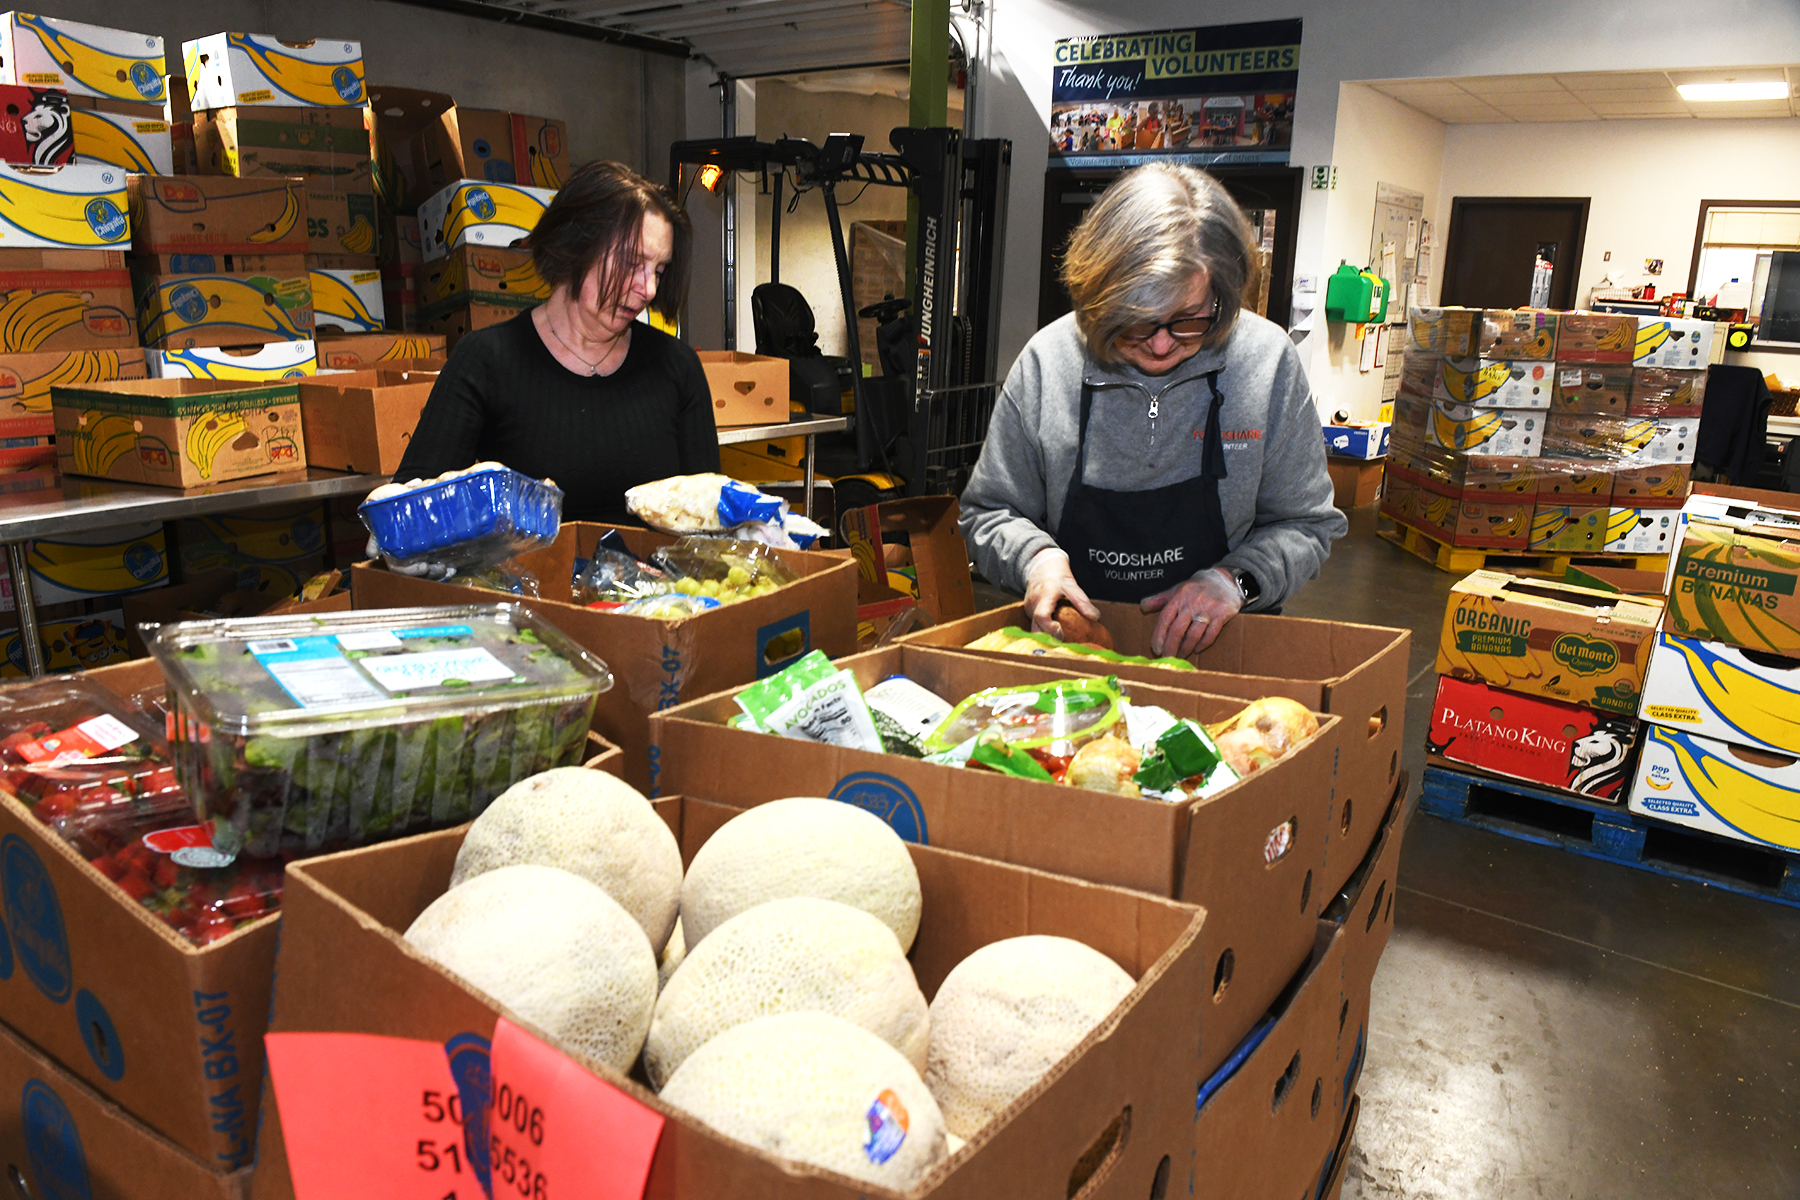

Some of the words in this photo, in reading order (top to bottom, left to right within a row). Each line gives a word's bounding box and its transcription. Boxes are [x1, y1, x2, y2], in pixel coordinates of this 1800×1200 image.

[1055, 33, 1193, 62] CELEBRATING
[1152, 48, 1294, 76] VOLUNTEERS
[137, 77, 162, 95] Chiquita
[340, 80, 361, 99] Chiquita
[1059, 65, 1103, 89] Thank
[1105, 72, 1142, 100] you!
[163, 184, 199, 200] Dole
[467, 191, 490, 208] Chiquita
[94, 215, 125, 237] Chiquita
[478, 259, 501, 271] Dole
[919, 216, 938, 347] JUNGHEINRICH
[171, 287, 199, 309] Chiquita
[333, 356, 360, 366] Dole
[1193, 429, 1263, 441] FODSHARE
[1088, 546, 1185, 567] FOODSHARE
[132, 555, 161, 579] Chiquita
[1104, 569, 1165, 581] VOLUNTEER
[1685, 560, 1769, 588] Premium
[1680, 579, 1779, 610] BANANAS
[1456, 607, 1531, 639] ORGANIC
[1471, 634, 1512, 645] PREMIUM
[1471, 643, 1512, 654] BANANAS
[1559, 642, 1576, 656] Del
[1578, 646, 1614, 664] Monte
[1571, 656, 1596, 669] Quality
[784, 680, 846, 730] AVOCADOS
[1600, 696, 1634, 710] BANDED
[1650, 705, 1675, 713] SELECTED
[1652, 711, 1673, 719] CLASS
[1674, 713, 1696, 721] EXTRA
[1651, 764, 1670, 775] pop
[1647, 798, 1672, 806] SELECTED
[1672, 801, 1694, 809] QUALITY
[1649, 804, 1670, 812] CLASS
[1670, 806, 1693, 814] EXTRA
[193, 989, 239, 1080] BX-07
[416, 1140, 461, 1173] 51
